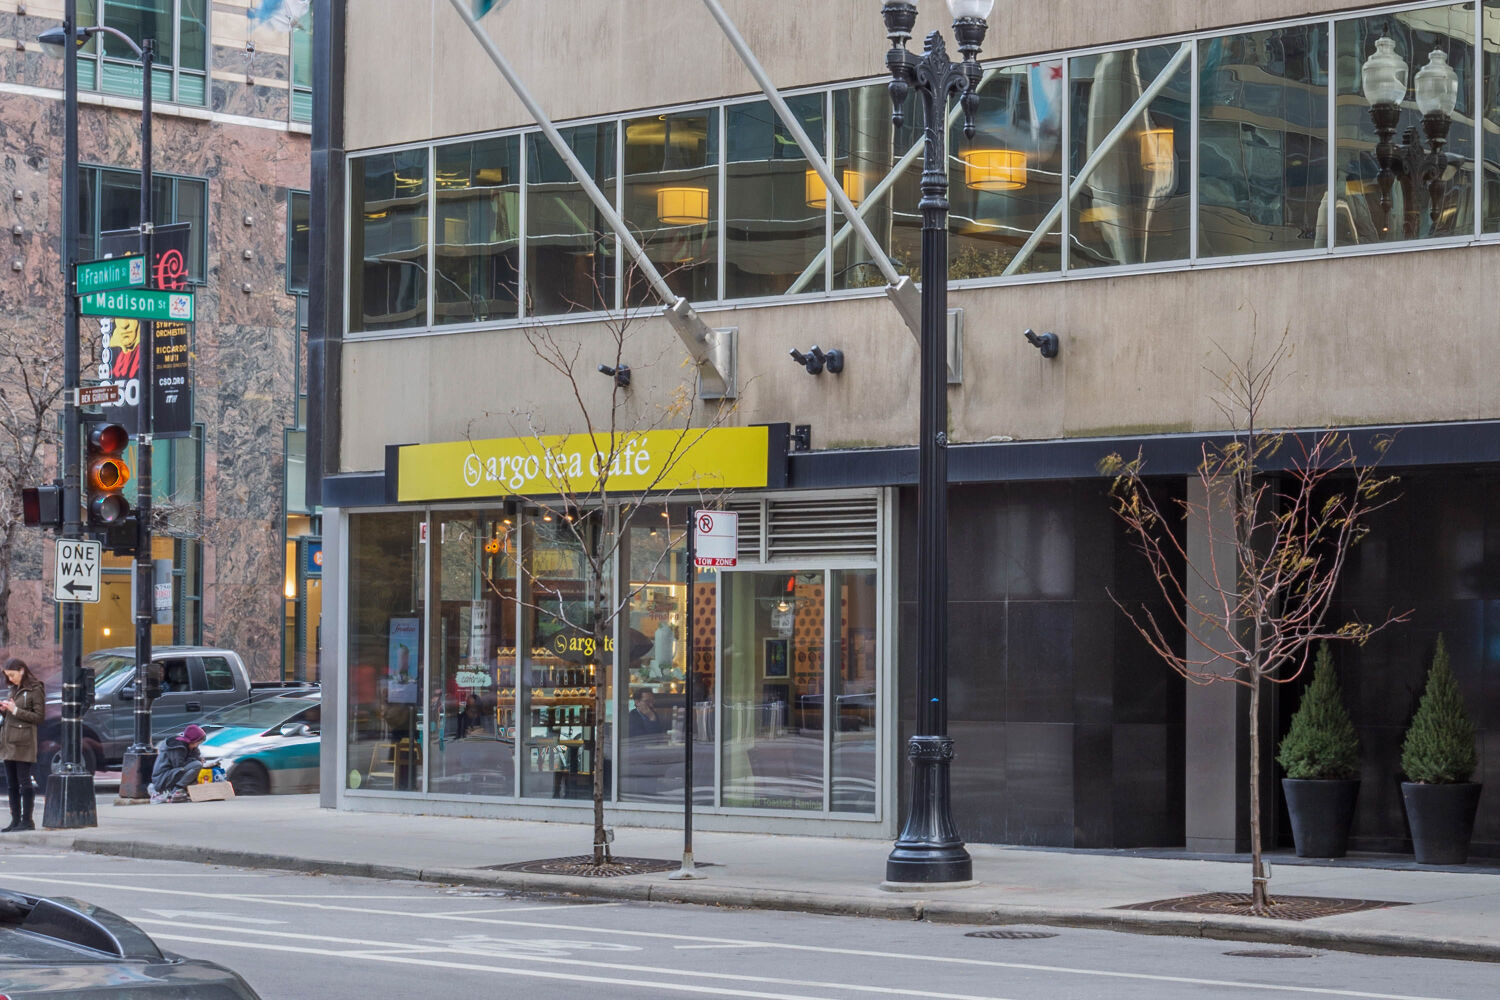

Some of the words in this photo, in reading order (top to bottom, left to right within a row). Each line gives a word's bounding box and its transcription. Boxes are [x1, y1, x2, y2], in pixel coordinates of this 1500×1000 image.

[85, 263, 120, 286] Franklin
[96, 292, 155, 312] Madison
[158, 299, 167, 310] St
[156, 344, 187, 354] RICCARDO
[159, 376, 185, 387] CSO.ORG
[485, 454, 540, 490] argo
[544, 447, 584, 479] tea
[589, 438, 651, 478] café
[62, 545, 95, 561] ONE
[698, 557, 713, 565] TOW
[715, 558, 734, 566] ZONE
[61, 562, 95, 578] WAY
[569, 636, 597, 657] arg
